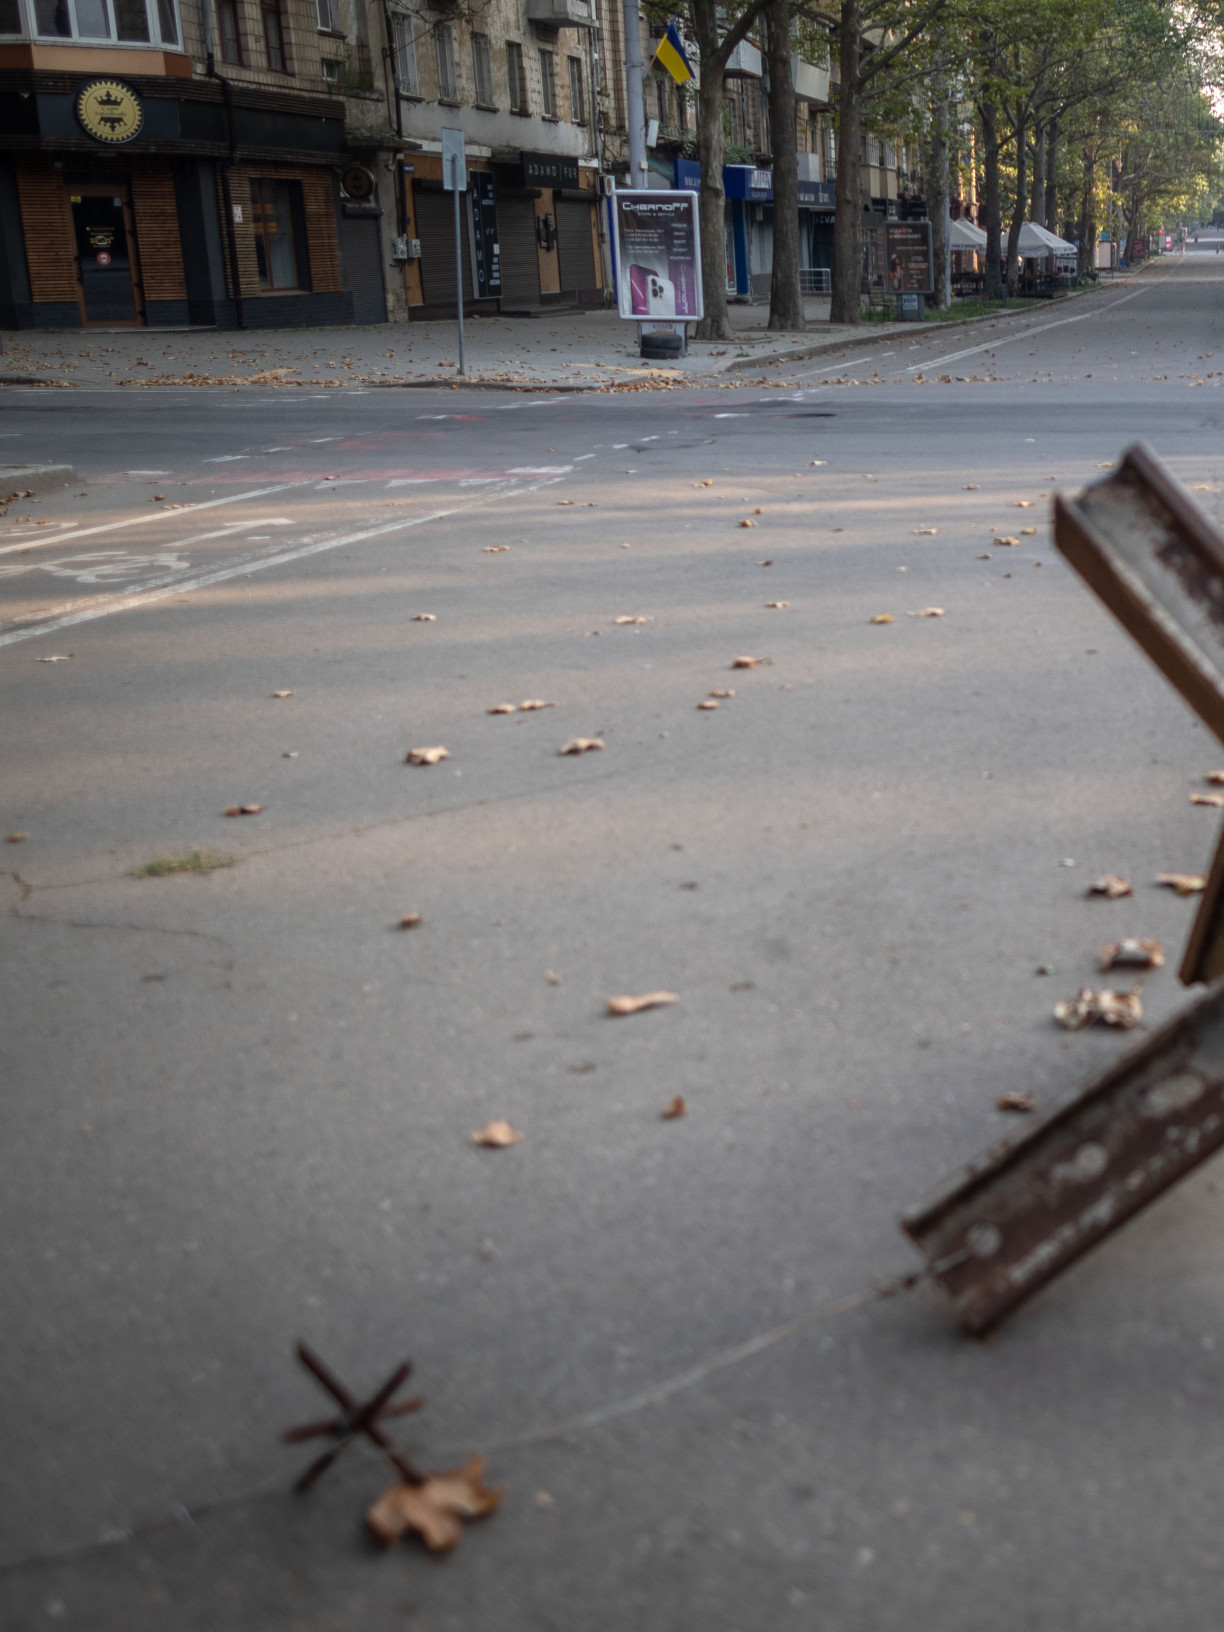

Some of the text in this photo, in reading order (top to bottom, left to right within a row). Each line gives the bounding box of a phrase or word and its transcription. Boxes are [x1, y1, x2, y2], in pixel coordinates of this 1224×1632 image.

[528, 163, 578, 179] ADAMO FUR
[473, 188, 485, 283] ADAMO
